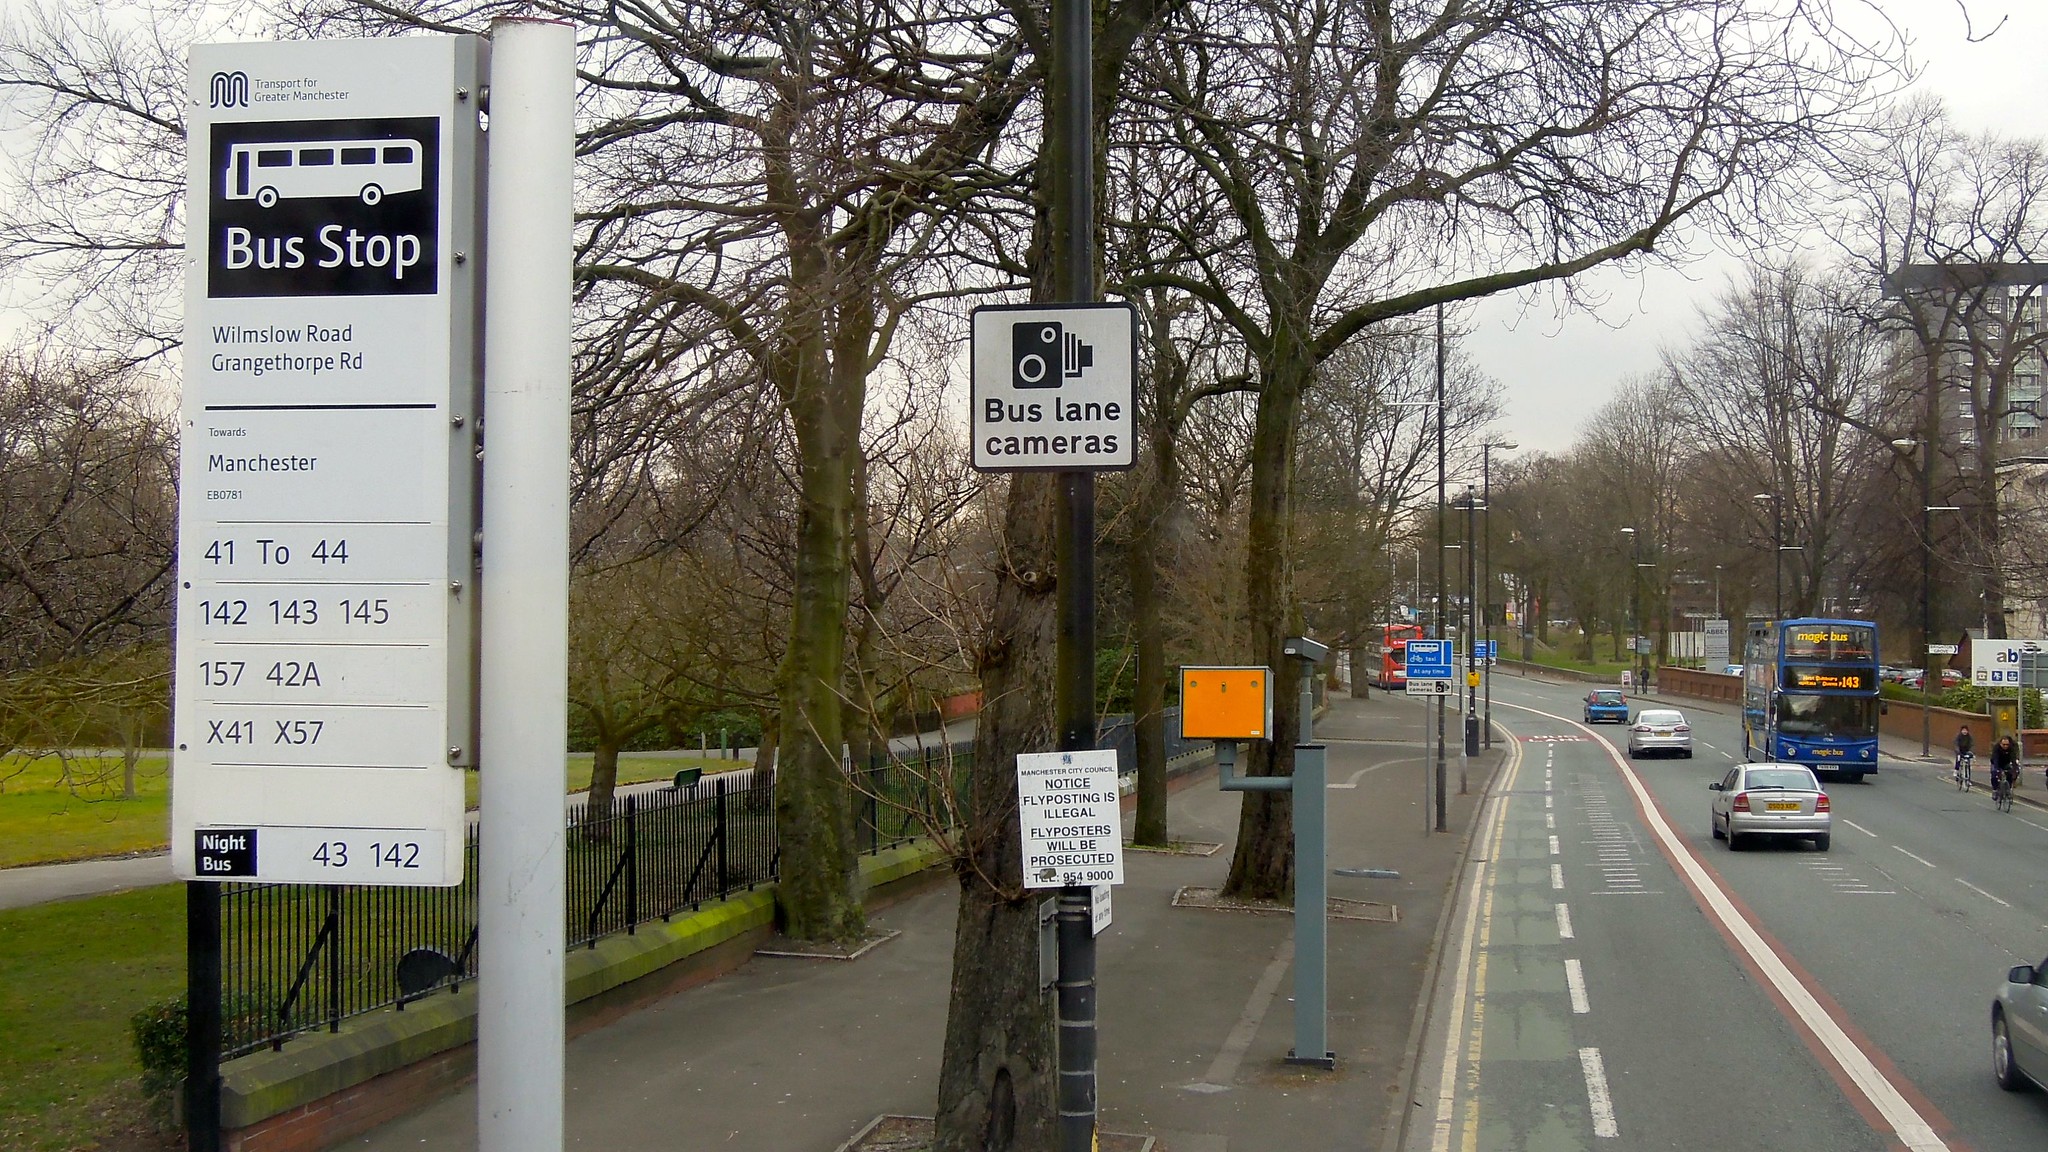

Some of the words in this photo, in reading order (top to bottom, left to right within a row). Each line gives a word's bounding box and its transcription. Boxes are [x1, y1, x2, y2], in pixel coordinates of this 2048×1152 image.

[254, 78, 301, 91] Transport
[303, 77, 318, 88] for
[254, 90, 291, 102] Greater
[292, 89, 350, 101] Manchester
[226, 227, 305, 270] Bus
[318, 224, 421, 280] Stop
[212, 325, 302, 344] Wilmslow
[307, 324, 352, 343] Road
[211, 352, 334, 377] Grangethorpe
[340, 351, 363, 370] Rd
[985, 398, 1043, 423] Bus
[1055, 396, 1121, 422] lane
[208, 427, 247, 437] Towards
[985, 434, 1119, 456] cameras
[208, 453, 317, 472] Manchester
[204, 540, 236, 565] 41
[256, 539, 290, 565] To
[311, 539, 349, 565] 44
[199, 600, 248, 625] 142
[268, 599, 318, 625] 143
[339, 599, 389, 625] 145
[1797, 631, 1829, 644] magic
[1830, 631, 1848, 642] bus
[199, 661, 246, 687] 157
[266, 661, 322, 687] 42A
[1841, 676, 1860, 688] 143
[206, 720, 255, 745] X41
[274, 720, 324, 745] X57
[1812, 749, 1832, 757] magic
[1021, 768, 1067, 777] MANCHESTER
[1068, 767, 1083, 775] CITY
[1084, 766, 1115, 774] COUNCIL
[1045, 778, 1091, 790] NOTICE
[1023, 793, 1100, 806] FLYPOSTING
[1104, 792, 1116, 803] IS
[1044, 808, 1096, 819] ILLEGAL
[1030, 825, 1112, 838] FLYPOSTERS
[202, 835, 247, 854] Night
[312, 842, 348, 869] 43
[369, 842, 420, 869] 142
[1047, 841, 1076, 852] WILL
[1080, 840, 1097, 850] BE
[203, 856, 232, 872] Bus
[1030, 853, 1115, 867] PROSECUTED
[1063, 872, 1083, 882] 954
[1086, 870, 1114, 881] 9000
